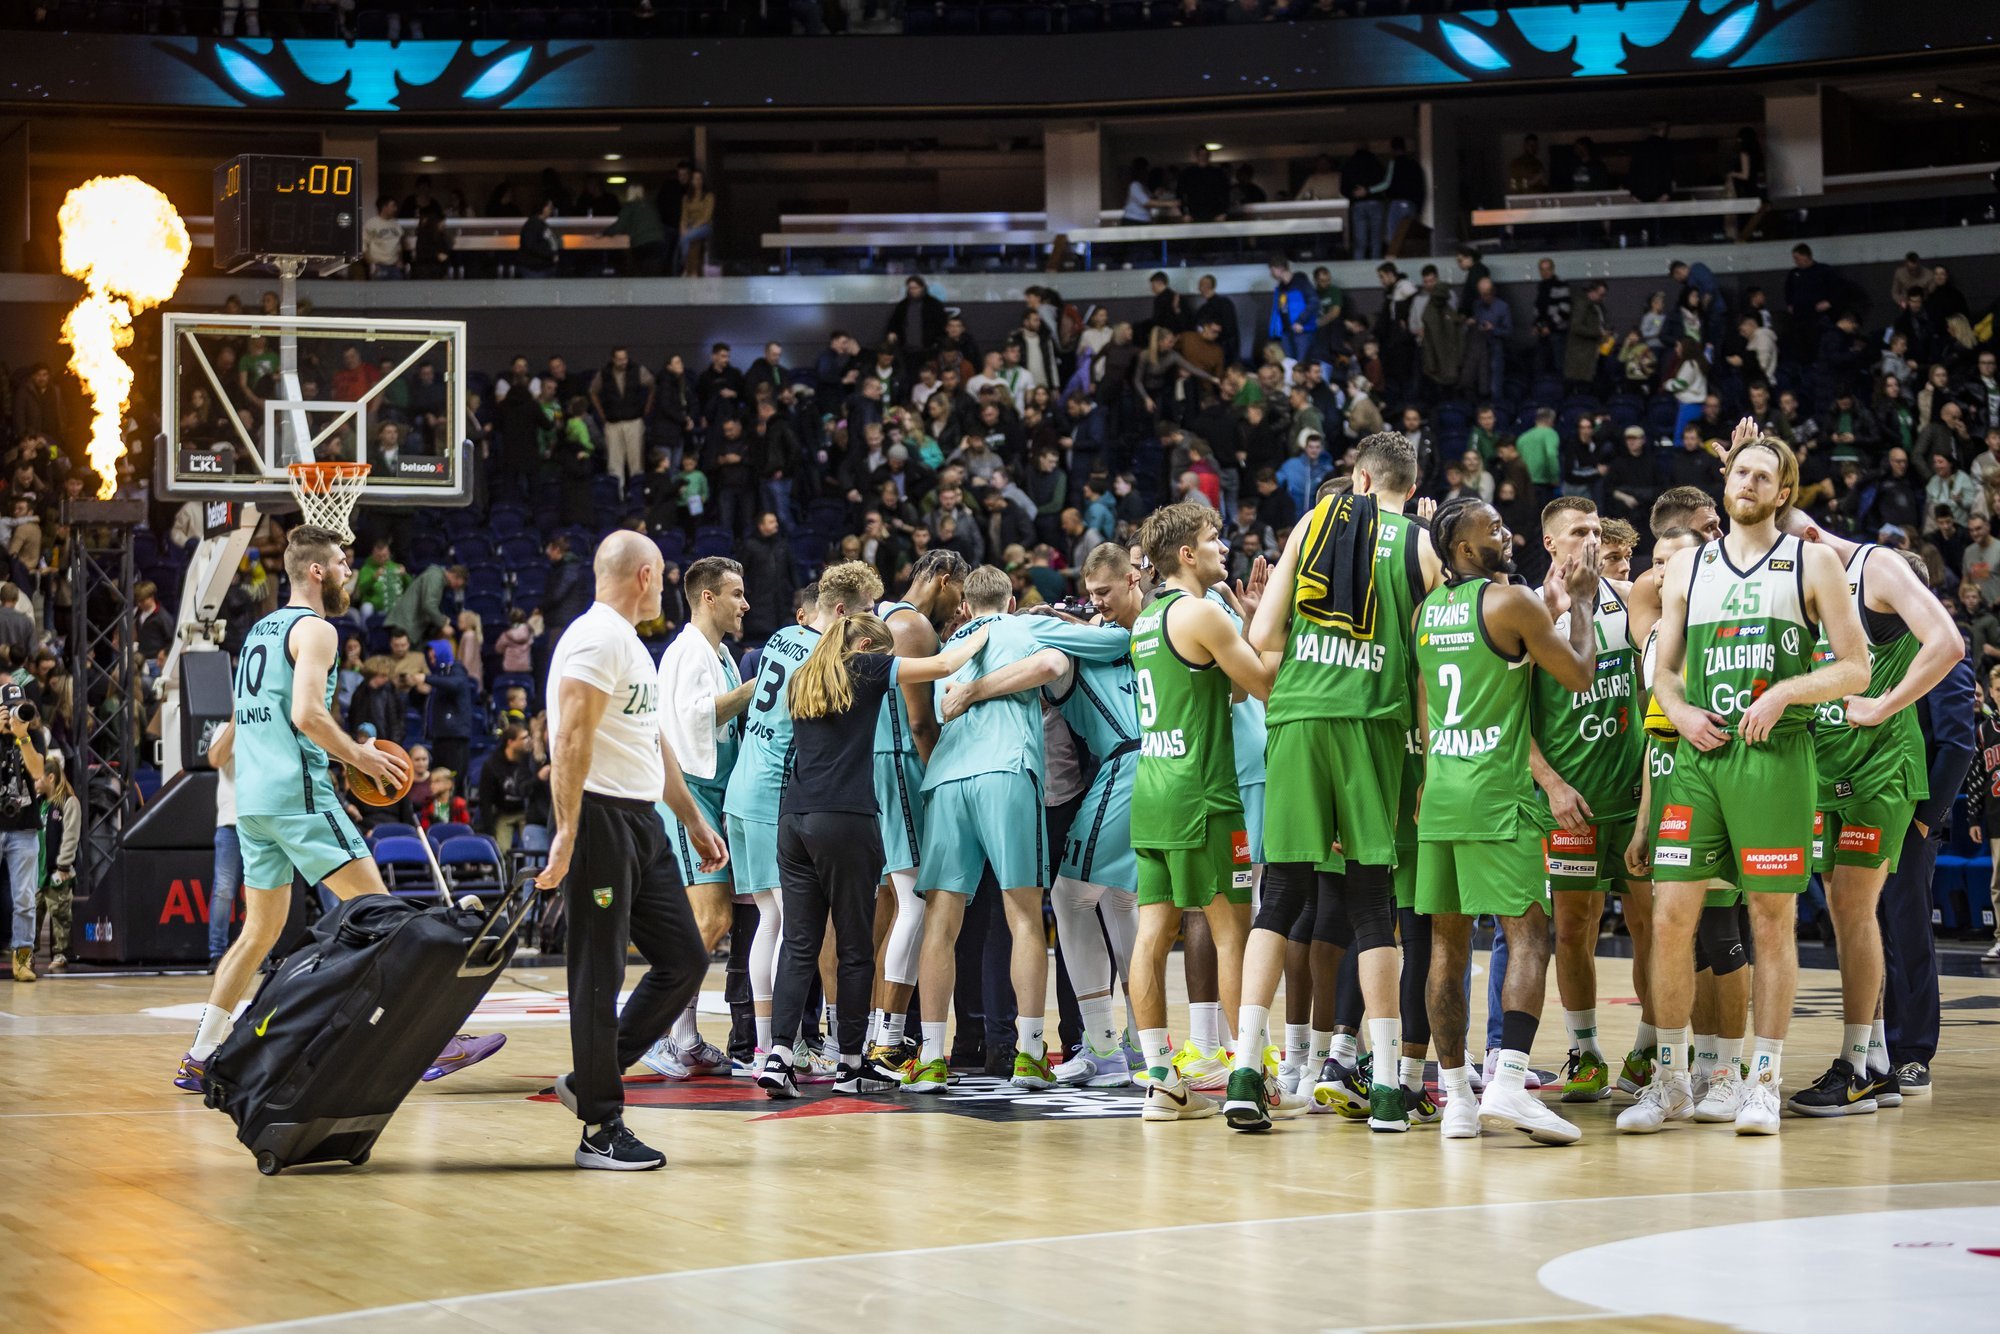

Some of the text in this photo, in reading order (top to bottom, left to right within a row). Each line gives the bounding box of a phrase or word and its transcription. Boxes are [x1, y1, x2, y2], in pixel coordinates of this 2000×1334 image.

[190, 461, 222, 472] LKL
[400, 462, 436, 473] betsafe
[1721, 582, 1762, 617] 45
[1424, 602, 1470, 628] EVANS
[766, 633, 809, 662] EMAITIS
[238, 644, 267, 699] 10
[1138, 668, 1157, 727] 9
[1438, 664, 1464, 726] 2
[1552, 833, 1593, 846] Samsonas
[1746, 853, 1799, 863] AKROPOLIS
[1756, 863, 1788, 871] KAUNAS
[766, 1060, 782, 1069] NIKE
